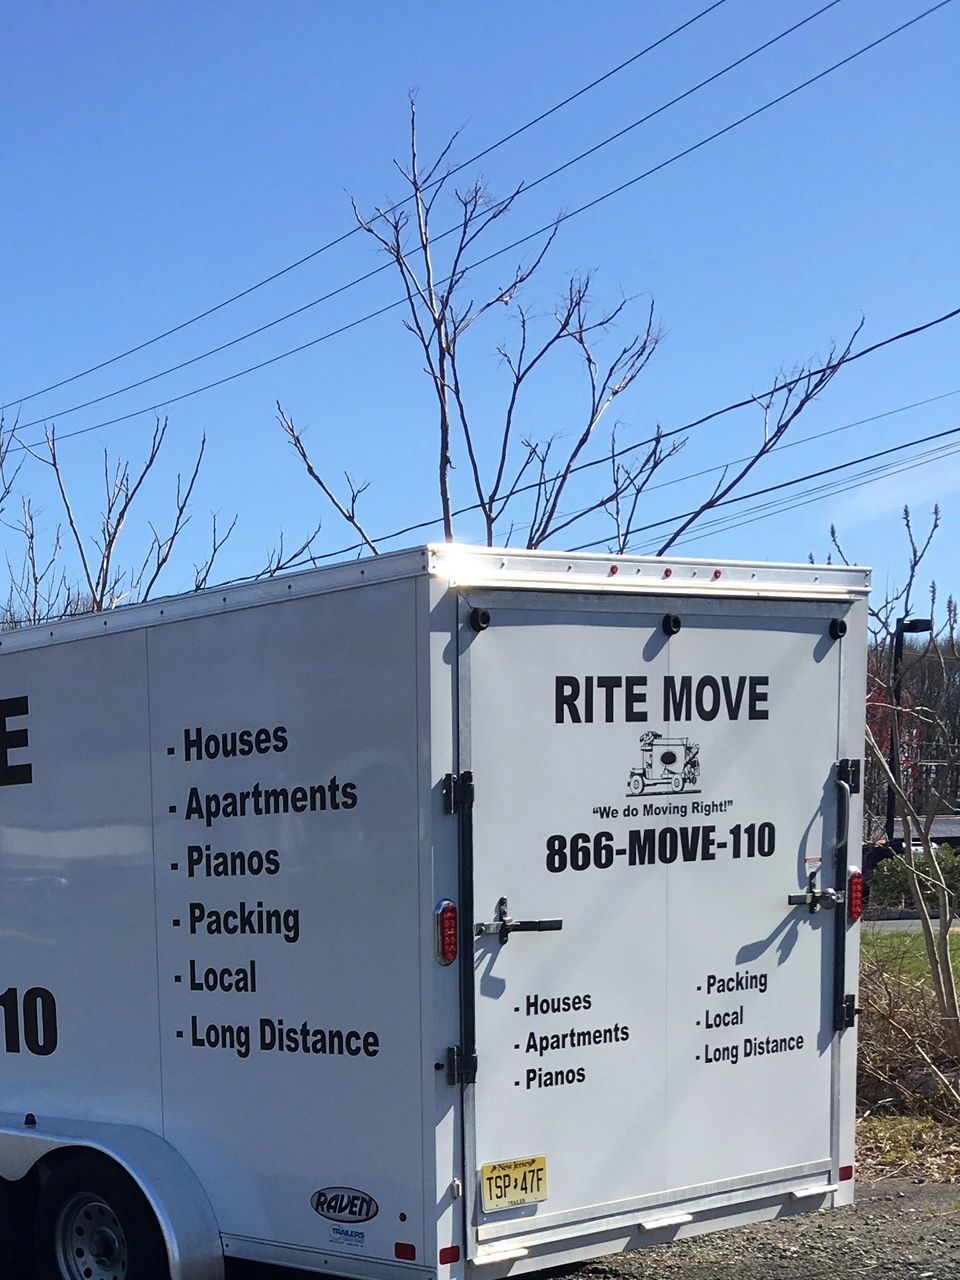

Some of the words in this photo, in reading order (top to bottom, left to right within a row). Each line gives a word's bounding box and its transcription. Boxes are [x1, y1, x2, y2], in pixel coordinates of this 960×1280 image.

[555, 675, 648, 724] RITE
[663, 675, 769, 721] MOVE
[184, 725, 288, 761] Houses
[185, 776, 358, 826] Apartments
[623, 804, 638, 818] do
[643, 802, 688, 819] Moving
[187, 844, 280, 877] Pianos
[546, 821, 776, 873] 866-MOVE-110
[189, 902, 300, 944] Packing
[189, 959, 256, 993] Local
[706, 971, 768, 995] Packing
[525, 993, 592, 1016] Houses
[704, 1006, 744, 1029] Local
[191, 1016, 251, 1058] Long
[260, 1018, 380, 1057] Distance
[525, 1023, 629, 1056] Apartments
[704, 1042, 739, 1064] Long
[744, 1034, 804, 1058] Distance
[526, 1066, 586, 1090] Pianos
[497, 1163, 512, 1171] New
[315, 1191, 373, 1217] RAVEN
[332, 1227, 365, 1239] TRAILERS
